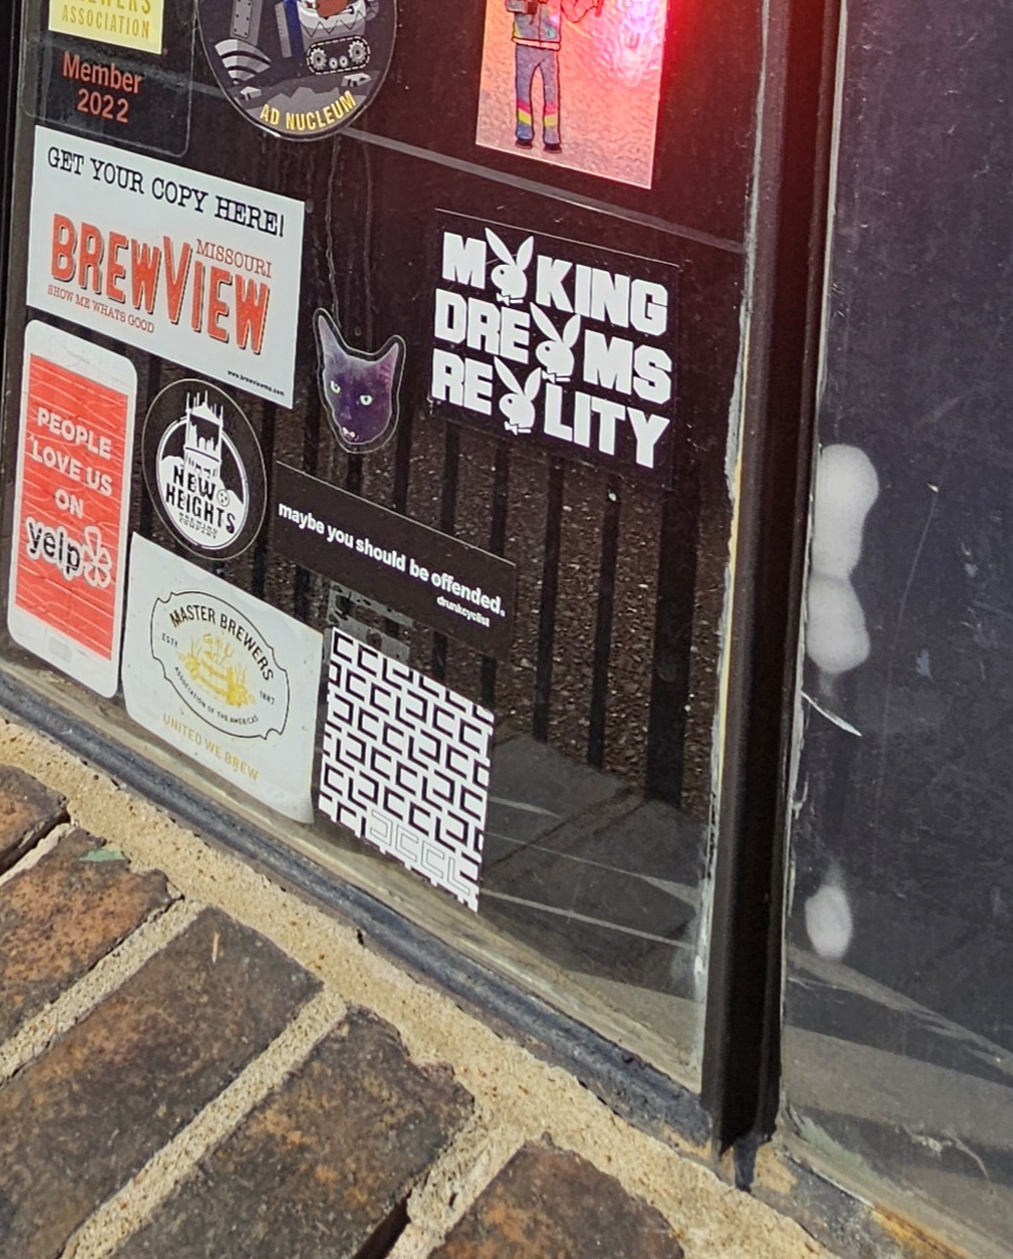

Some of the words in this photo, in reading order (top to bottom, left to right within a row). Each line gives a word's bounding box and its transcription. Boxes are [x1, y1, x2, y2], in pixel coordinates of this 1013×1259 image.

[61, 4, 150, 40] ASSOCIATION
[62, 50, 143, 94] Member
[76, 88, 130, 124] 2022
[259, 104, 281, 126] AD
[286, 89, 357, 132] NUCLEUM
[48, 146, 85, 176] GET
[90, 157, 145, 195] YOUR
[151, 177, 209, 214] COPY
[214, 194, 286, 238] HERE!
[51, 213, 271, 356] BREWVIEW
[195, 238, 273, 279] MISSOURI
[441, 227, 669, 337] MKING
[48, 284, 74, 303] SHOW
[75, 292, 91, 309] ME
[92, 299, 127, 324] WHATS
[127, 314, 155, 334] GOOD
[434, 288, 673, 405] DREMS
[37, 406, 113, 460] PEOPLE
[431, 348, 671, 469] RELITY
[31, 439, 81, 482] LOVE
[86, 466, 114, 497] US
[173, 464, 217, 502] NEW
[54, 488, 84, 518] ON
[165, 483, 236, 534] HEIGHTS
[26, 518, 82, 578] yelp
[278, 503, 325, 535] maybe
[326, 524, 354, 549] you
[355, 538, 406, 573] should
[409, 558, 430, 582] be
[431, 572, 506, 618] offended.
[437, 596, 491, 628] drunkcyclist
[169, 604, 217, 629] MASTER
[219, 614, 274, 682] BREWERS
[174, 666, 207, 709] ASSOCIATION
[216, 711, 230, 722] THE
[229, 714, 259, 726] AMERICAS
[259, 689, 276, 705] 1887
[162, 712, 203, 746] UNITED
[205, 739, 222, 759] WE
[224, 751, 259, 782] BREW
